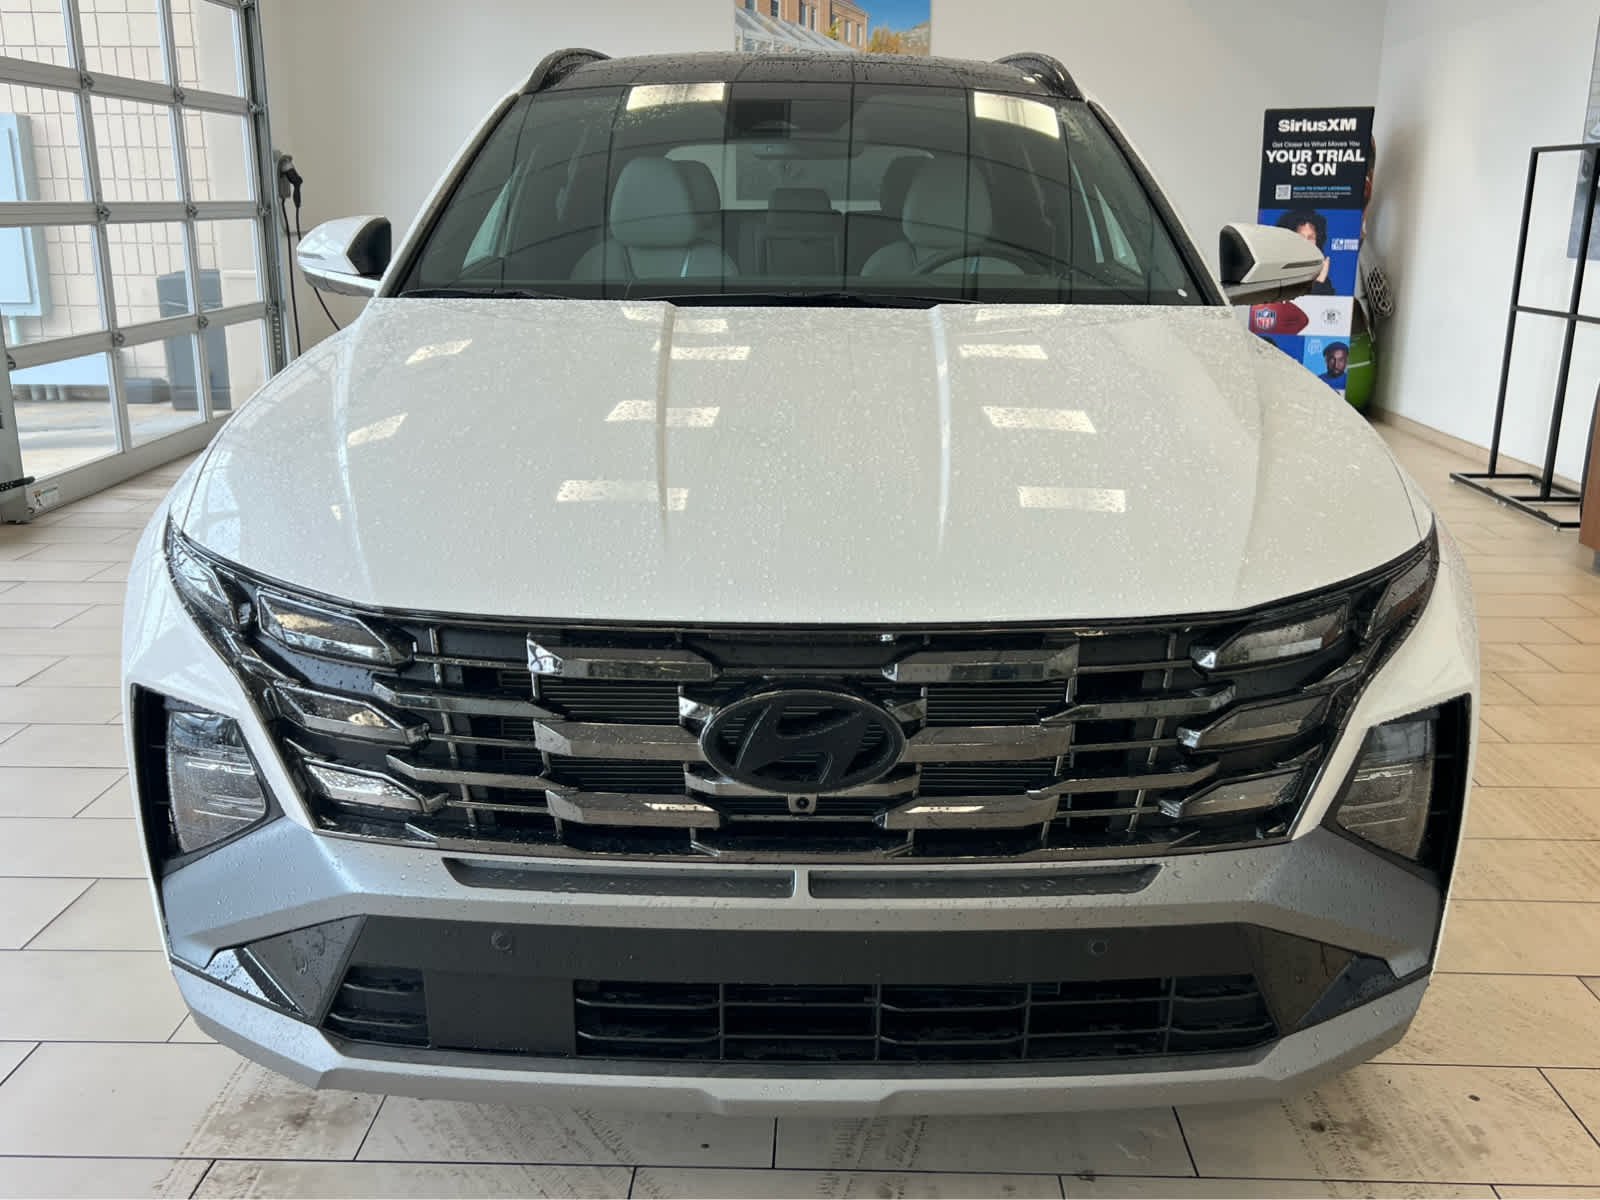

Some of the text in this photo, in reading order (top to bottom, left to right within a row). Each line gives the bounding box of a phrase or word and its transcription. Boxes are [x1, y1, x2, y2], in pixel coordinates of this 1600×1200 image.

[1278, 118, 1357, 132] SiriusXM
[1266, 149, 1365, 162] YOUR TRIAL
[1291, 163, 1337, 176] IS ON
